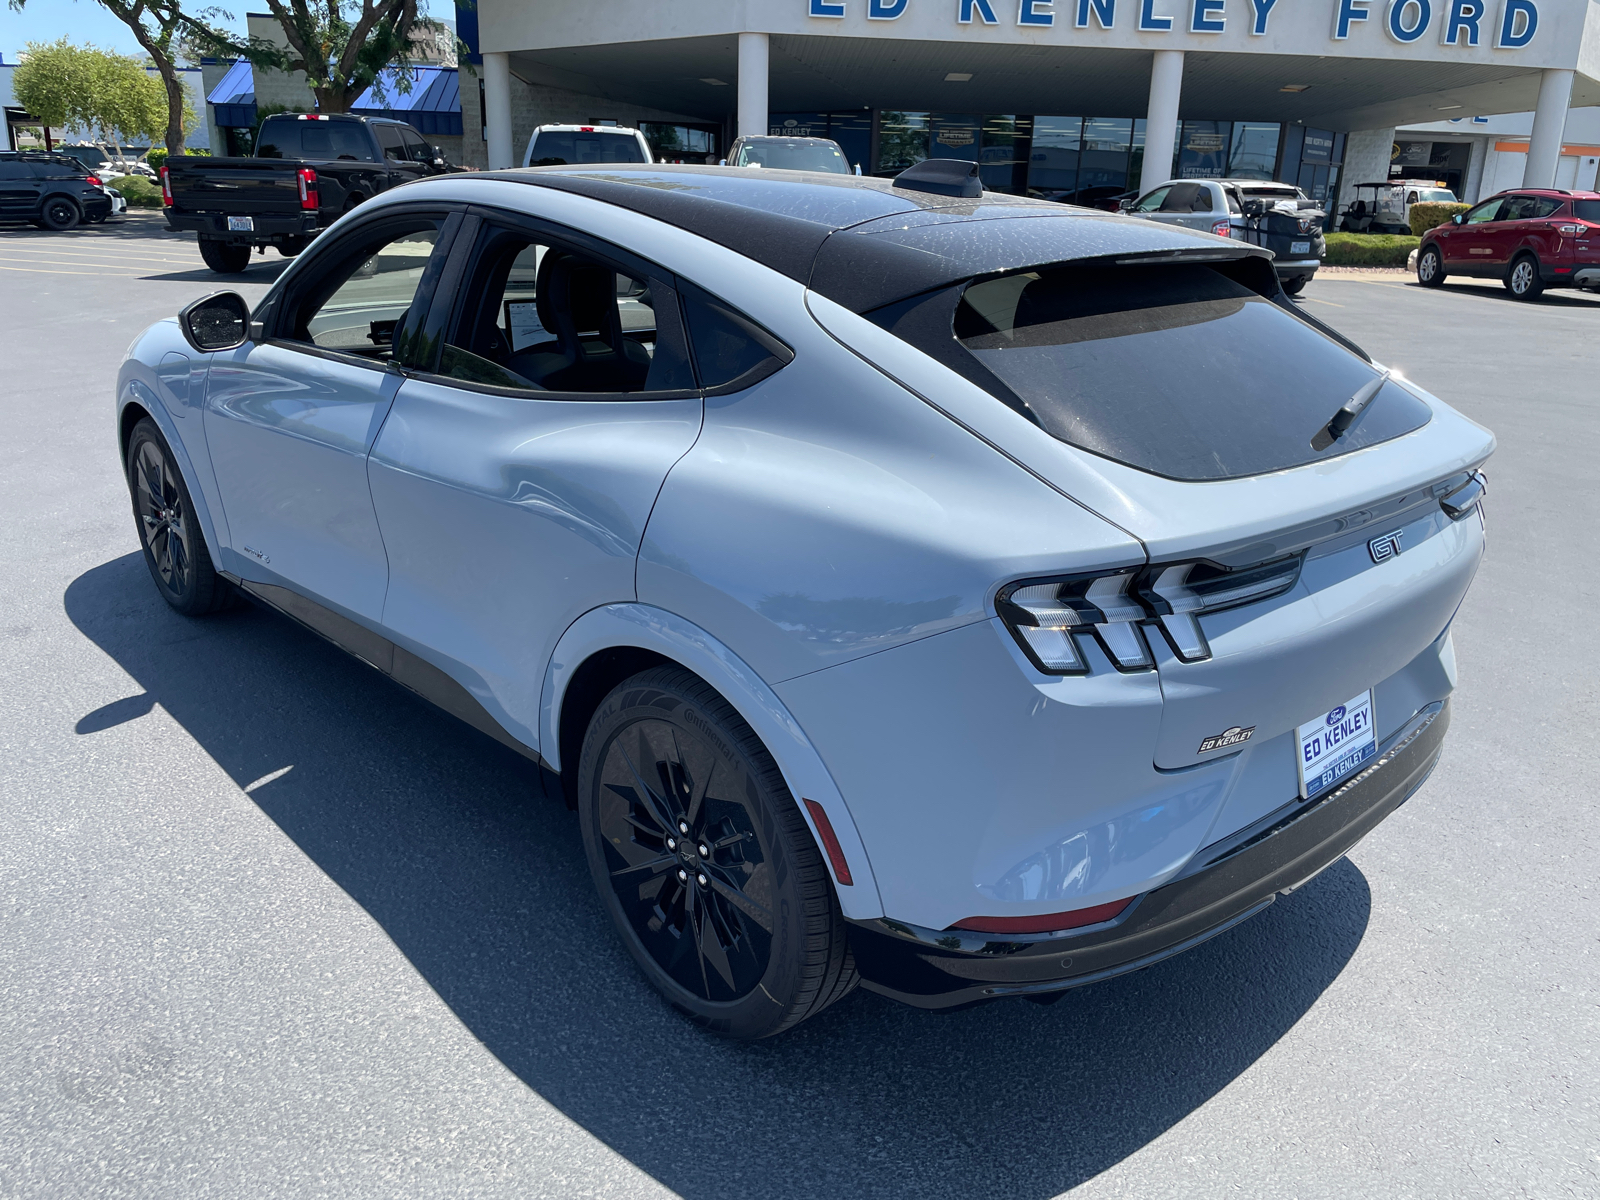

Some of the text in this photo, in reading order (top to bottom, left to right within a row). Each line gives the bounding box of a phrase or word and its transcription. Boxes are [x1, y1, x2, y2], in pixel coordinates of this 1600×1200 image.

[1334, 0, 1538, 48] FORD
[782, 128, 811, 136] KENLEY
[1367, 529, 1404, 564] GT
[1303, 737, 1321, 762] ED
[1324, 707, 1369, 751] KENLEY
[1328, 708, 1345, 725] Ford
[684, 708, 735, 762] Continental
[1200, 740, 1216, 751] ED
[1216, 730, 1254, 748] KENLEY
[1321, 770, 1333, 786] ED
[1334, 749, 1364, 778] KENLEY
